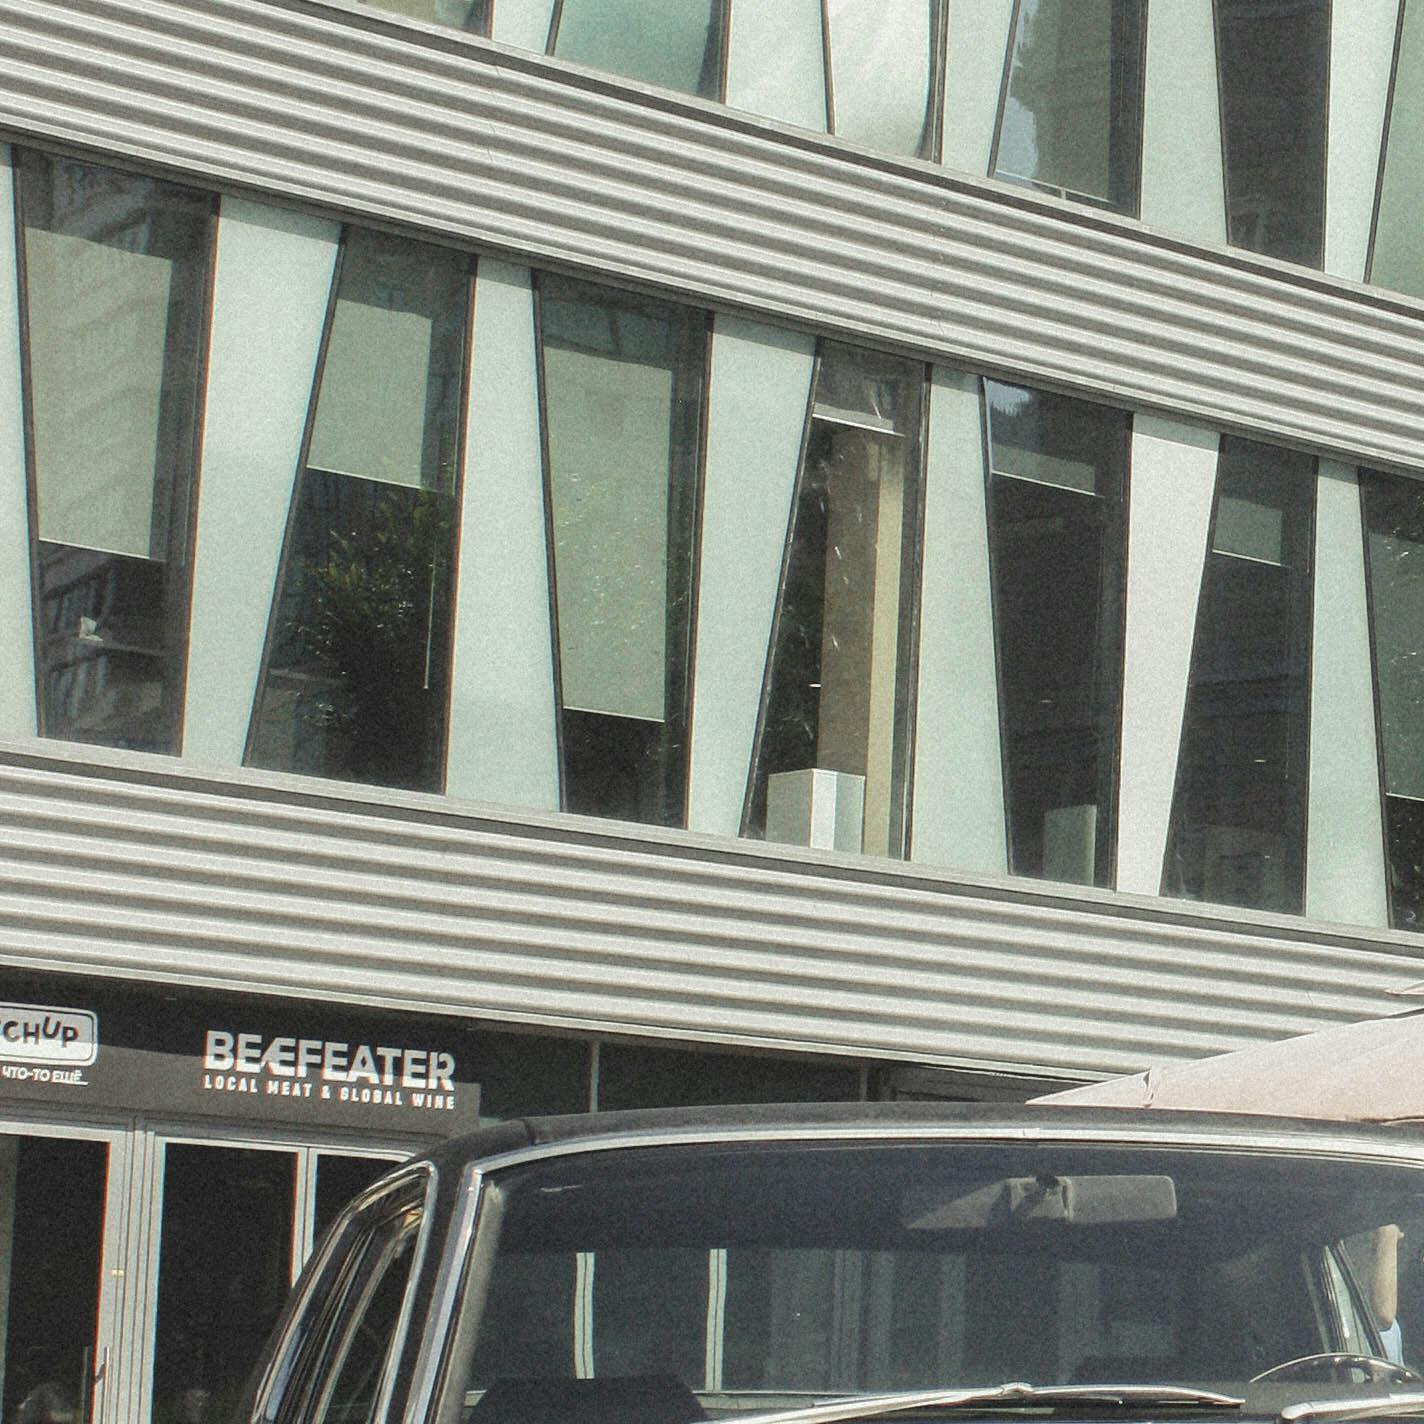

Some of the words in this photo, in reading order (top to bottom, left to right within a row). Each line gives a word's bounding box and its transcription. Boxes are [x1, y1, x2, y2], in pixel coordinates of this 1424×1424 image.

[0, 1016, 79, 1048] CHUP
[204, 1030, 456, 1091] BEEFEATER
[204, 1075, 258, 1094] LOCAL
[266, 1080, 312, 1098] MEAT
[320, 1086, 331, 1100] &
[339, 1087, 403, 1106] GLOBAL
[411, 1093, 456, 1110] WINE
